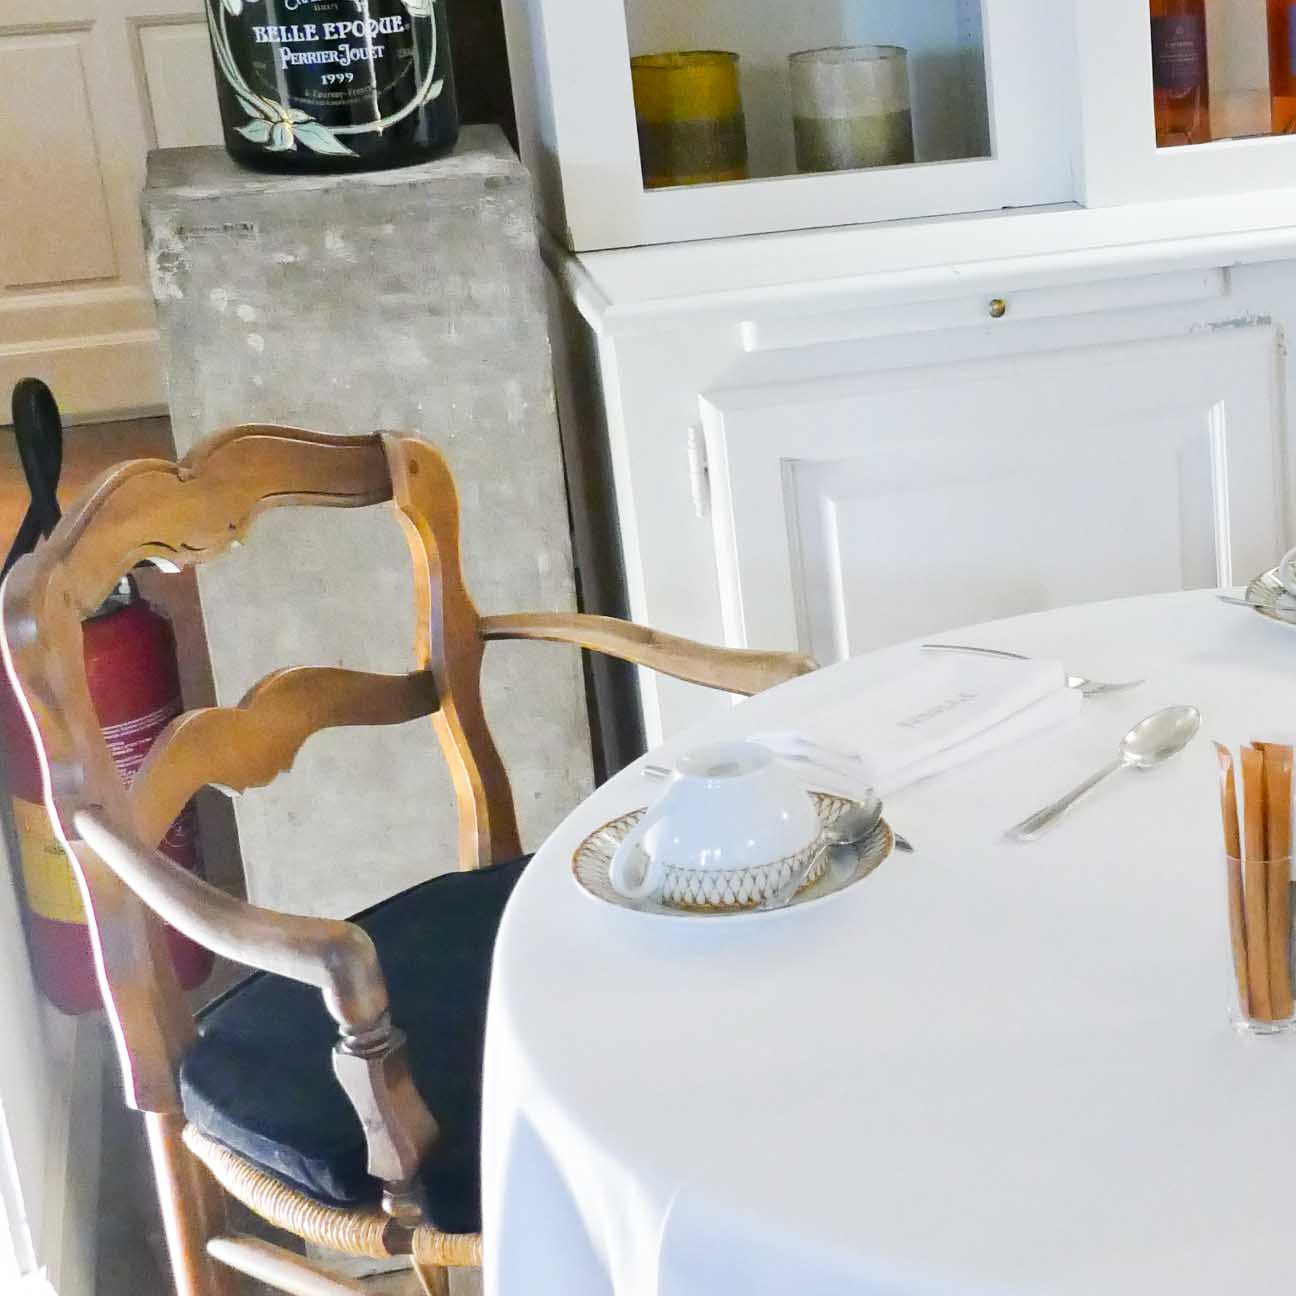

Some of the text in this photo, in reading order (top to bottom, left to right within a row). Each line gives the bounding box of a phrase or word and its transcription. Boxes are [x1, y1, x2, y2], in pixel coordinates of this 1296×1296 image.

[252, 15, 405, 43] BELLE EPOQUE
[321, 72, 354, 86] 1999
